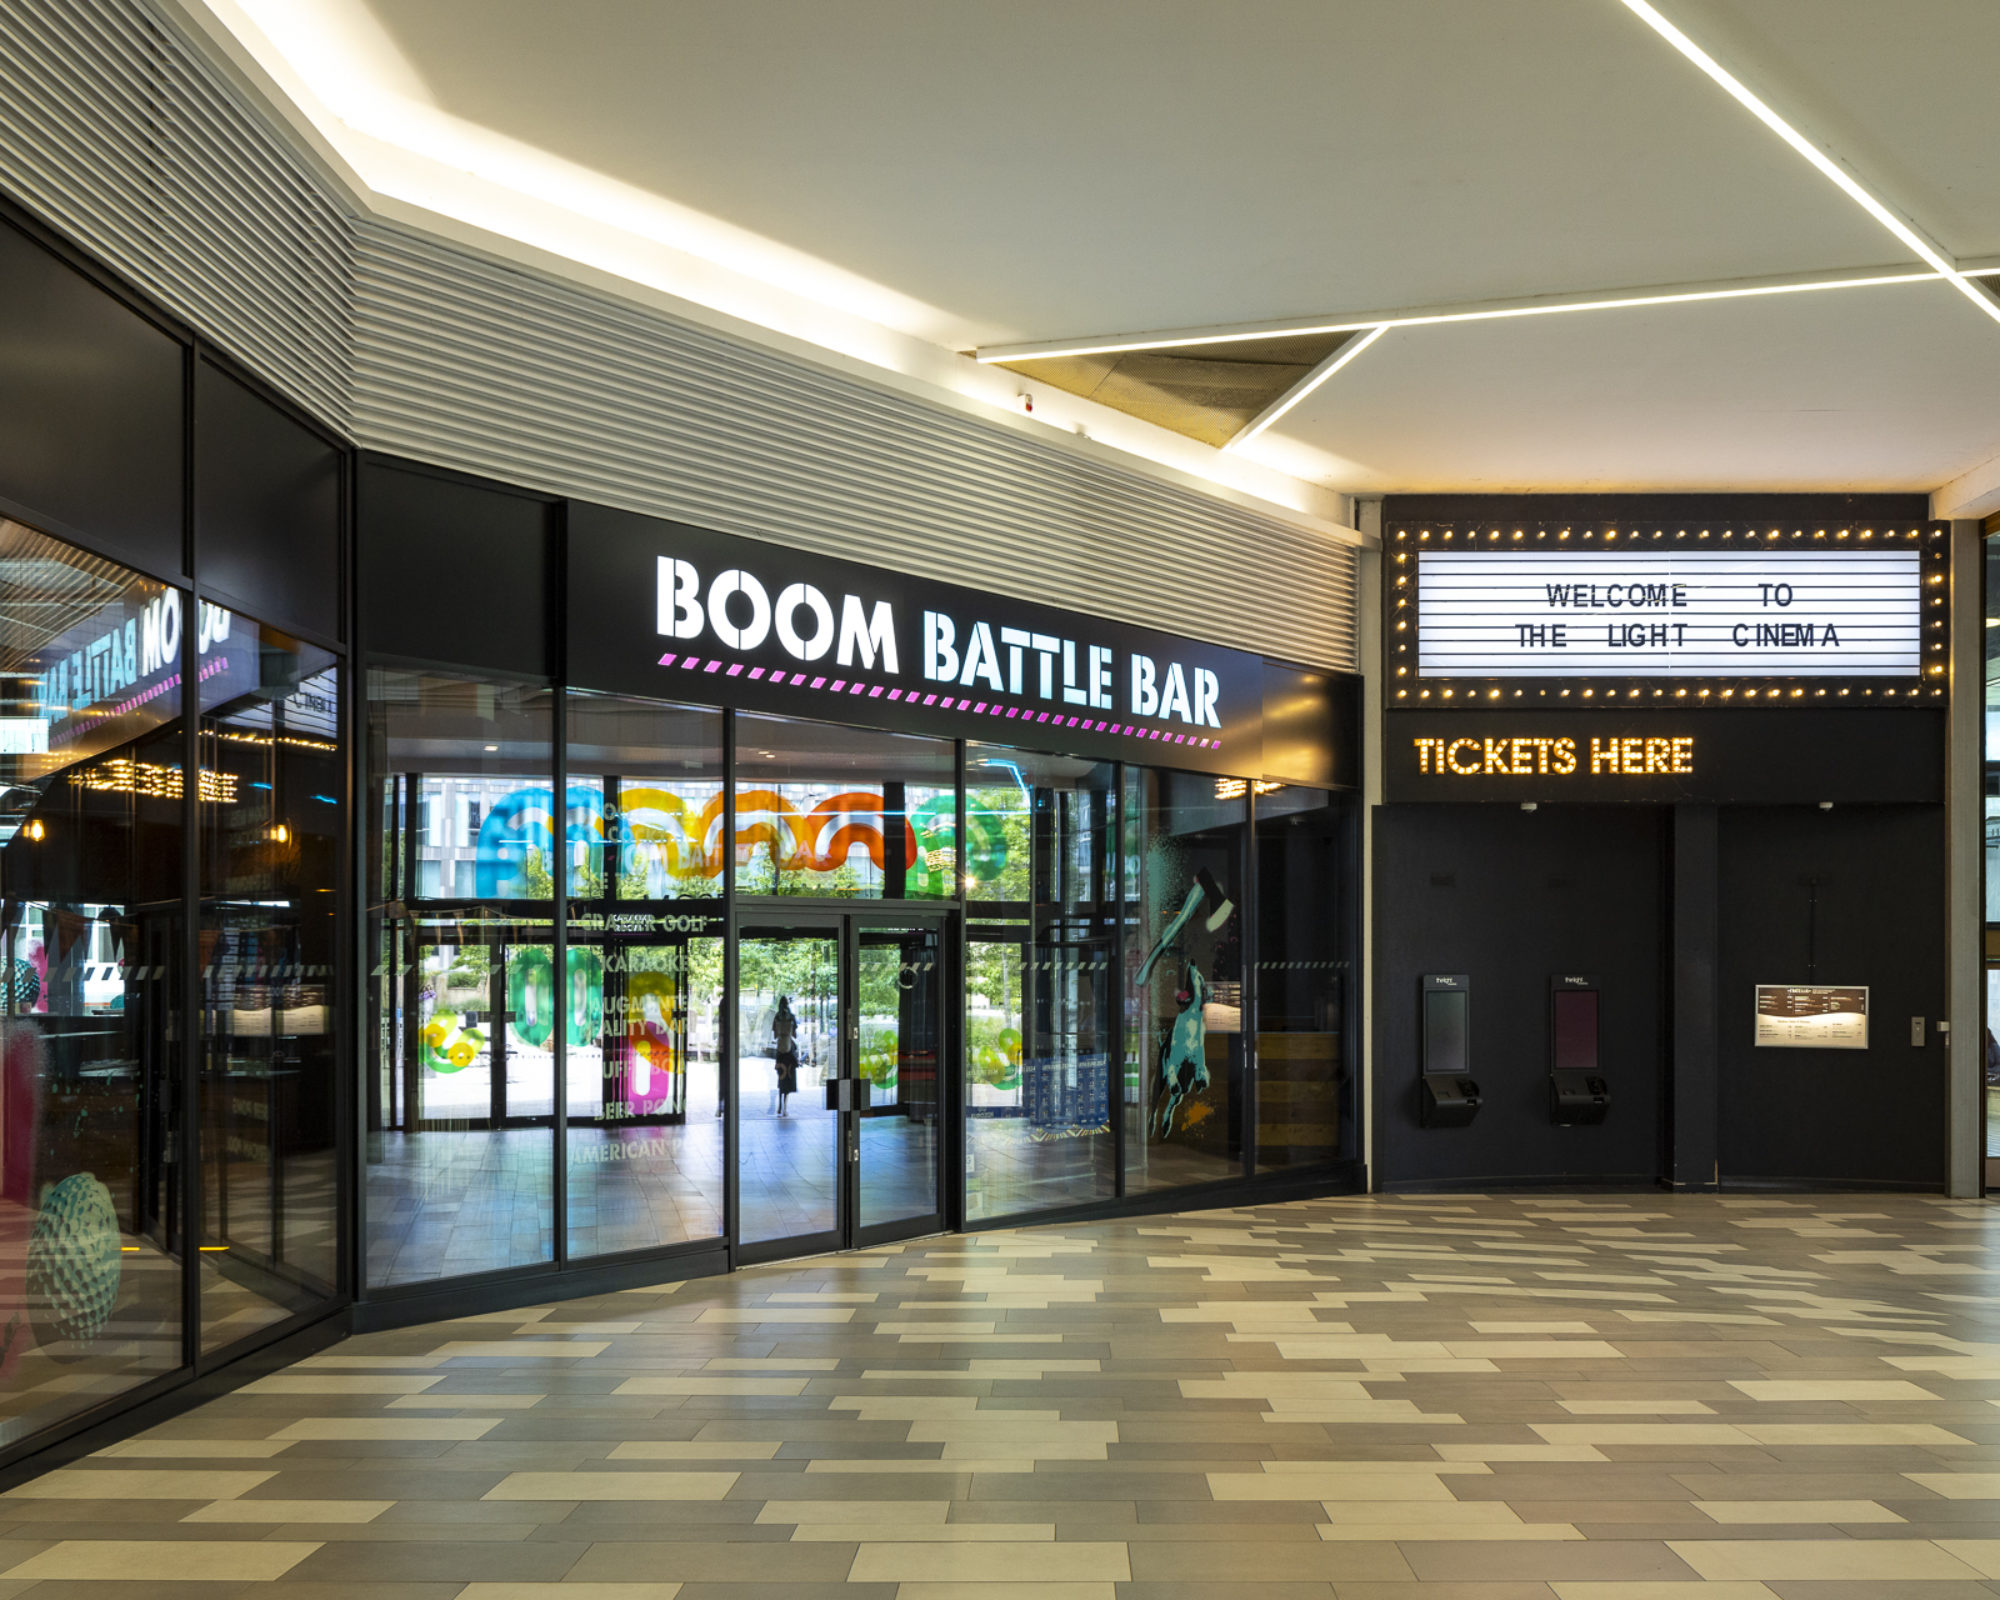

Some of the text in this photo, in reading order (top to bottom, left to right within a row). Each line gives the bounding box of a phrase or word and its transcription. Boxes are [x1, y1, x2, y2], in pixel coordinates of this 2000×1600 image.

[1546, 584, 1794, 608] WELCOME TO
[657, 555, 1222, 729] BOOM BATTLE BAR
[1515, 624, 1840, 648] THE LIGHT CINEMA
[1414, 737, 1694, 775] TICKETS HERE
[663, 914, 708, 932] GOLF
[602, 954, 688, 973] KARAOKE
[571, 1138, 666, 1164] AMERICAN
